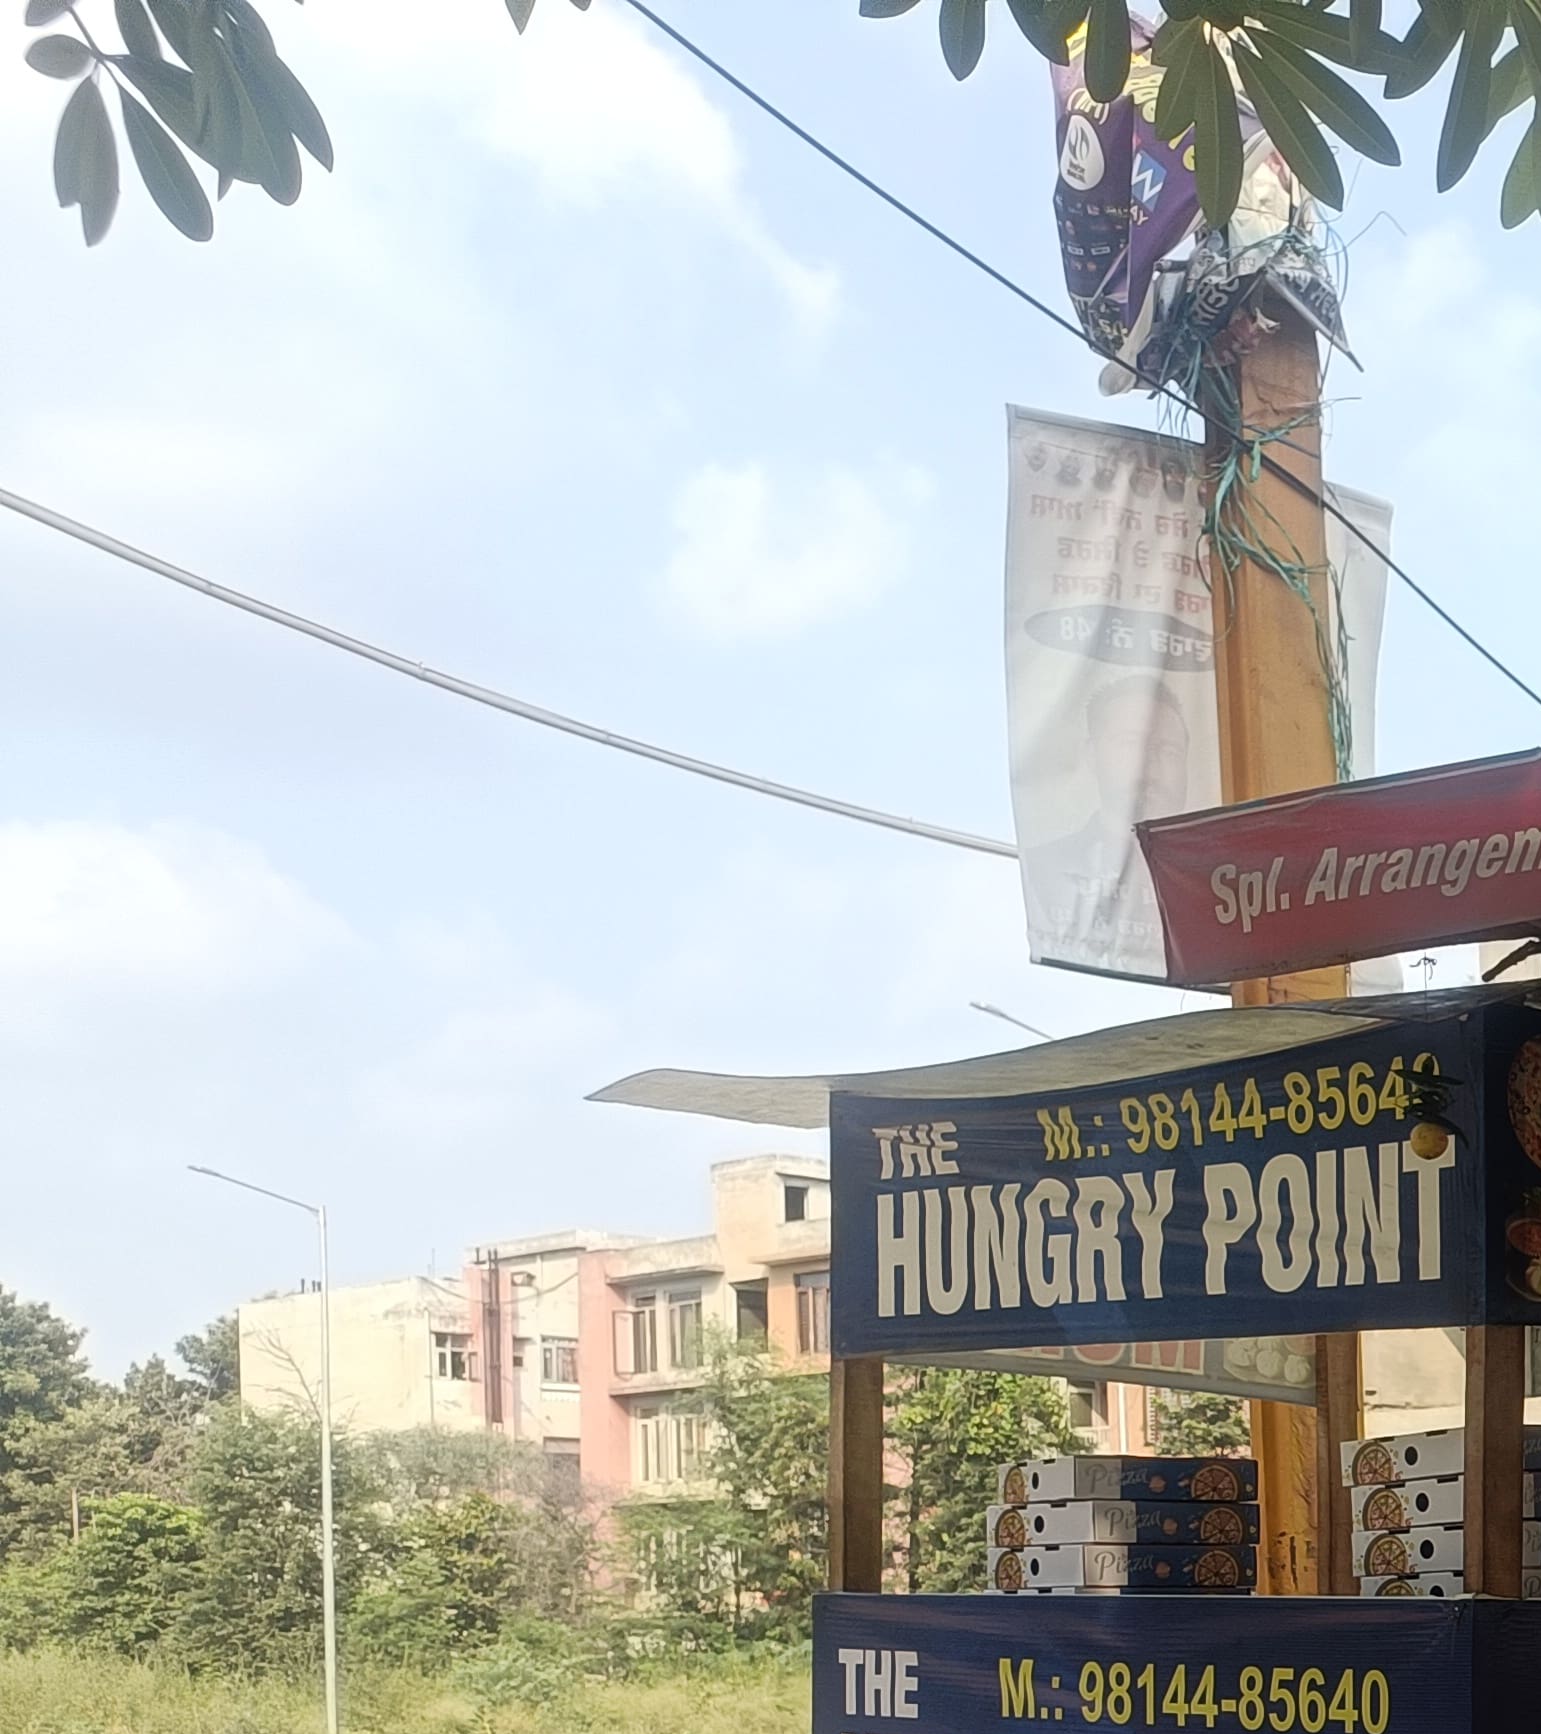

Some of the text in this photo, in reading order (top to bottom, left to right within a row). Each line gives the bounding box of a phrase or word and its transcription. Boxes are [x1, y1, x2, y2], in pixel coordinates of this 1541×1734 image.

[1212, 857, 1291, 934] Spl.
[873, 1122, 960, 1181] THE
[1036, 1106, 1104, 1162] M.:
[877, 1134, 1457, 1318] HUNGRY POINT
[1085, 1463, 1150, 1494] Pizza
[1104, 1507, 1161, 1537] Pizza
[1094, 1551, 1153, 1582] Pizza
[839, 1649, 919, 1718] THE
[999, 1658, 1063, 1721] M.:
